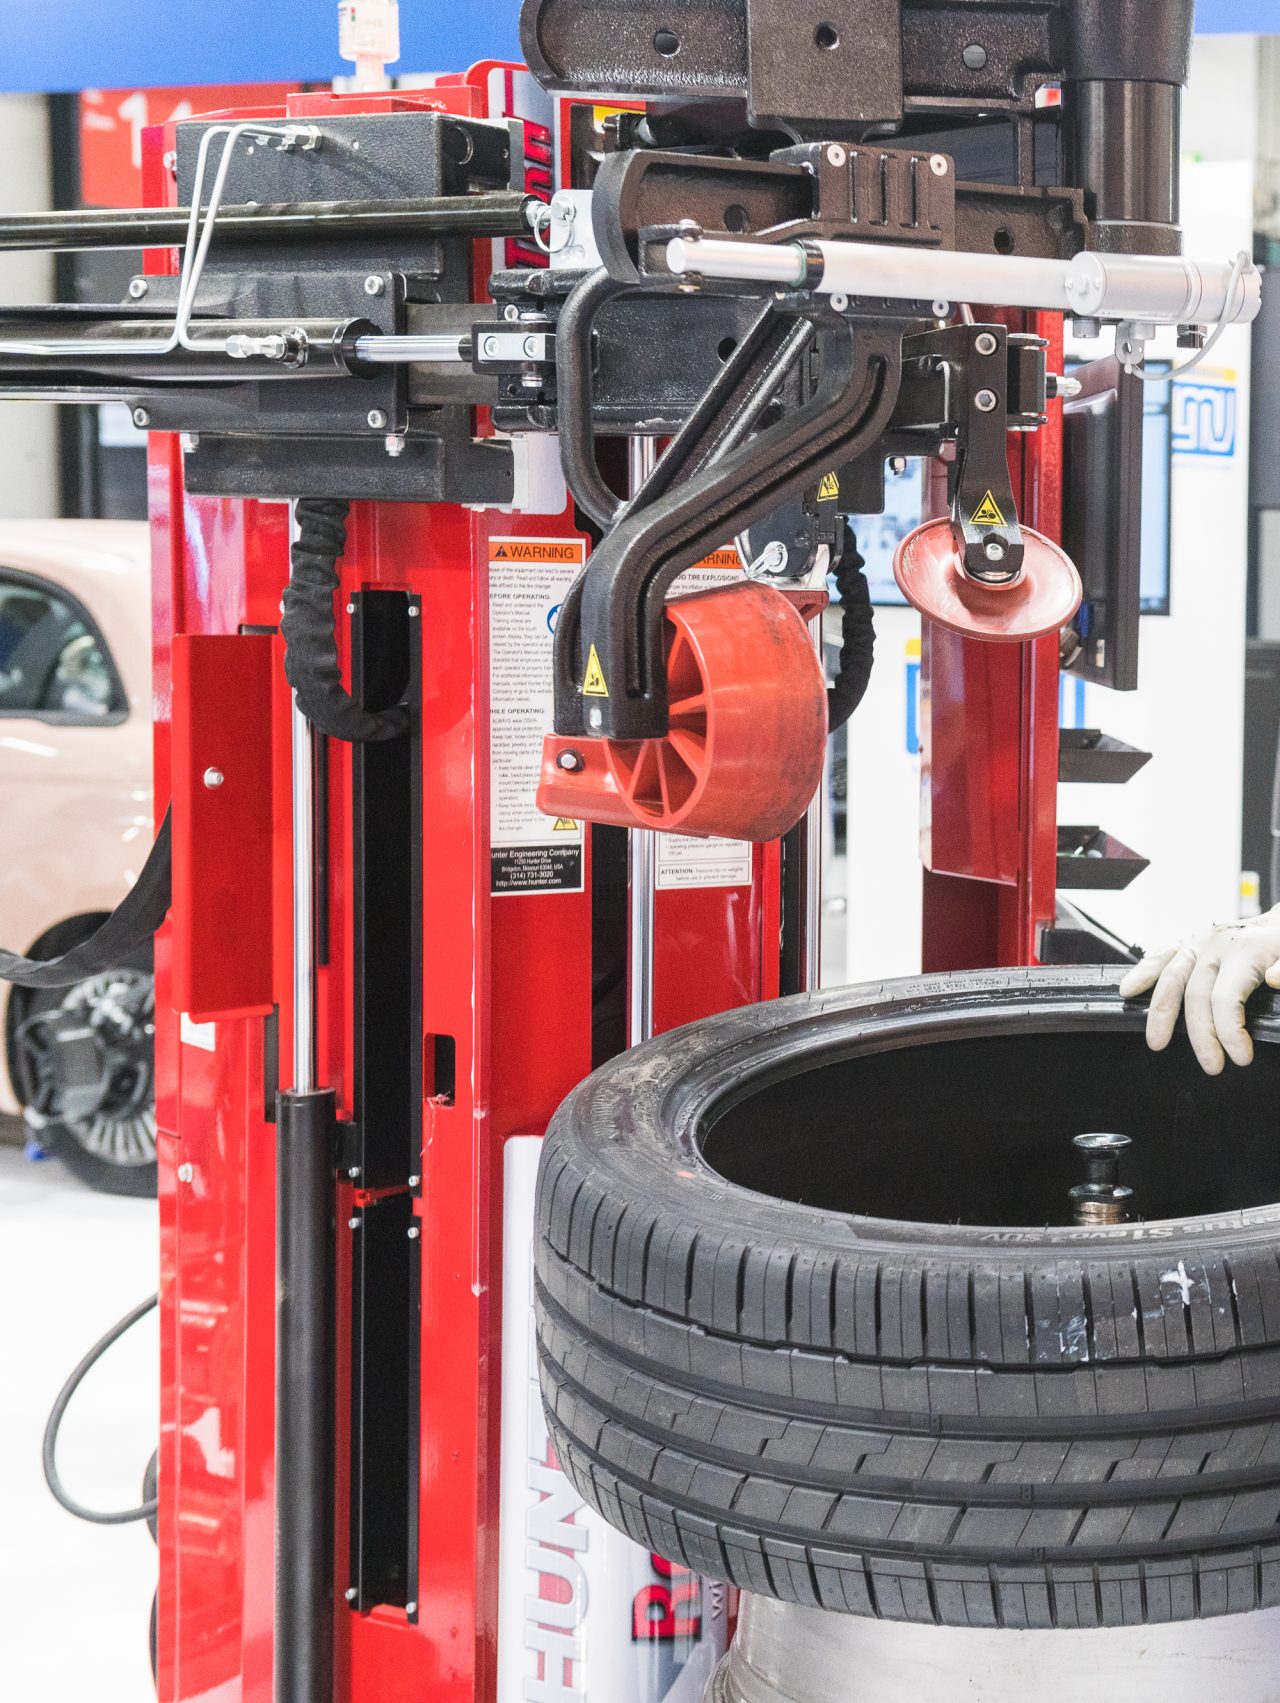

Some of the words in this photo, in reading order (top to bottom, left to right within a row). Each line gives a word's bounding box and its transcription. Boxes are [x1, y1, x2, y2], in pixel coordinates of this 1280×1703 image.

[511, 546, 574, 558] WARNING
[703, 554, 741, 565] RNING
[1133, 1227, 1175, 1241] S1
